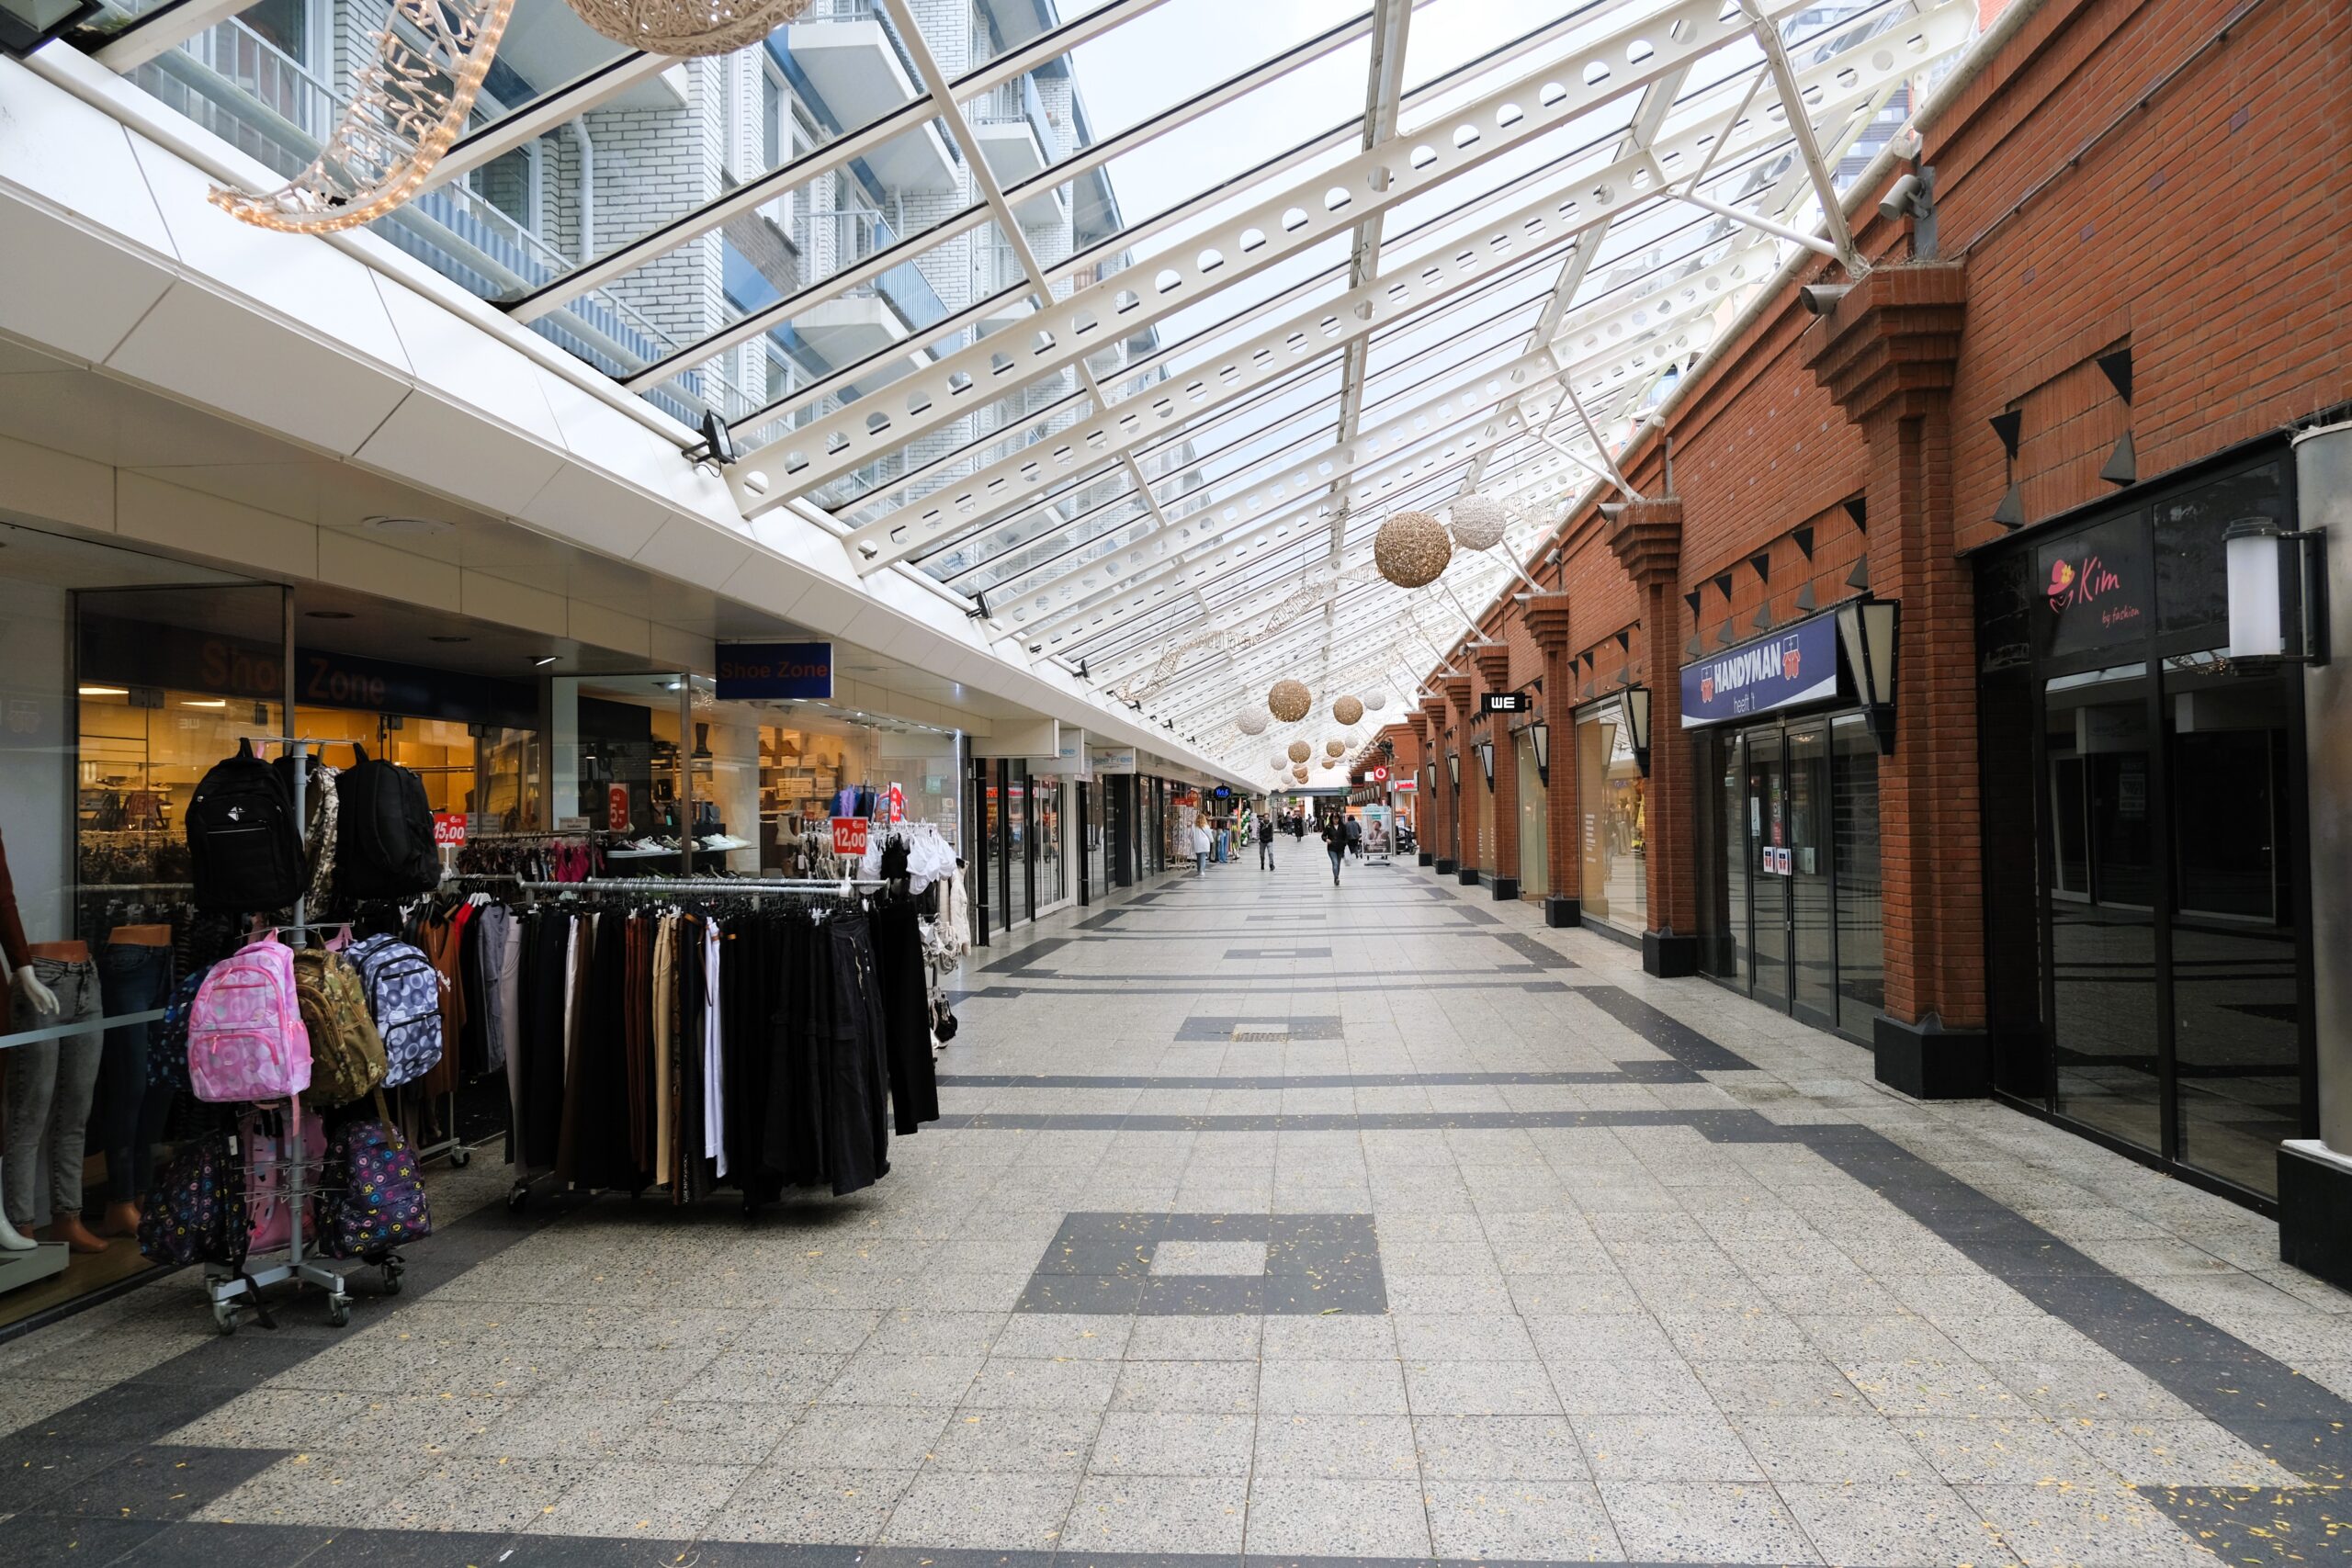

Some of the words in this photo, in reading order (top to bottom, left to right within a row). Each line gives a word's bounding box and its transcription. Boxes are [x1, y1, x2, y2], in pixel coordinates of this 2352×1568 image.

[2078, 556, 2120, 604] Kim
[2101, 610, 2111, 628] by
[2112, 604, 2140, 623] fashion
[201, 639, 287, 694] Sho
[308, 656, 387, 705] Zone
[720, 660, 772, 679] Shoe
[777, 660, 829, 678] Zone
[1713, 641, 1781, 694] HANDYMAN
[1490, 696, 1515, 709] WE
[1733, 694, 1750, 714] heeft
[434, 821, 465, 842] 15,00
[834, 827, 865, 852] 12,00
